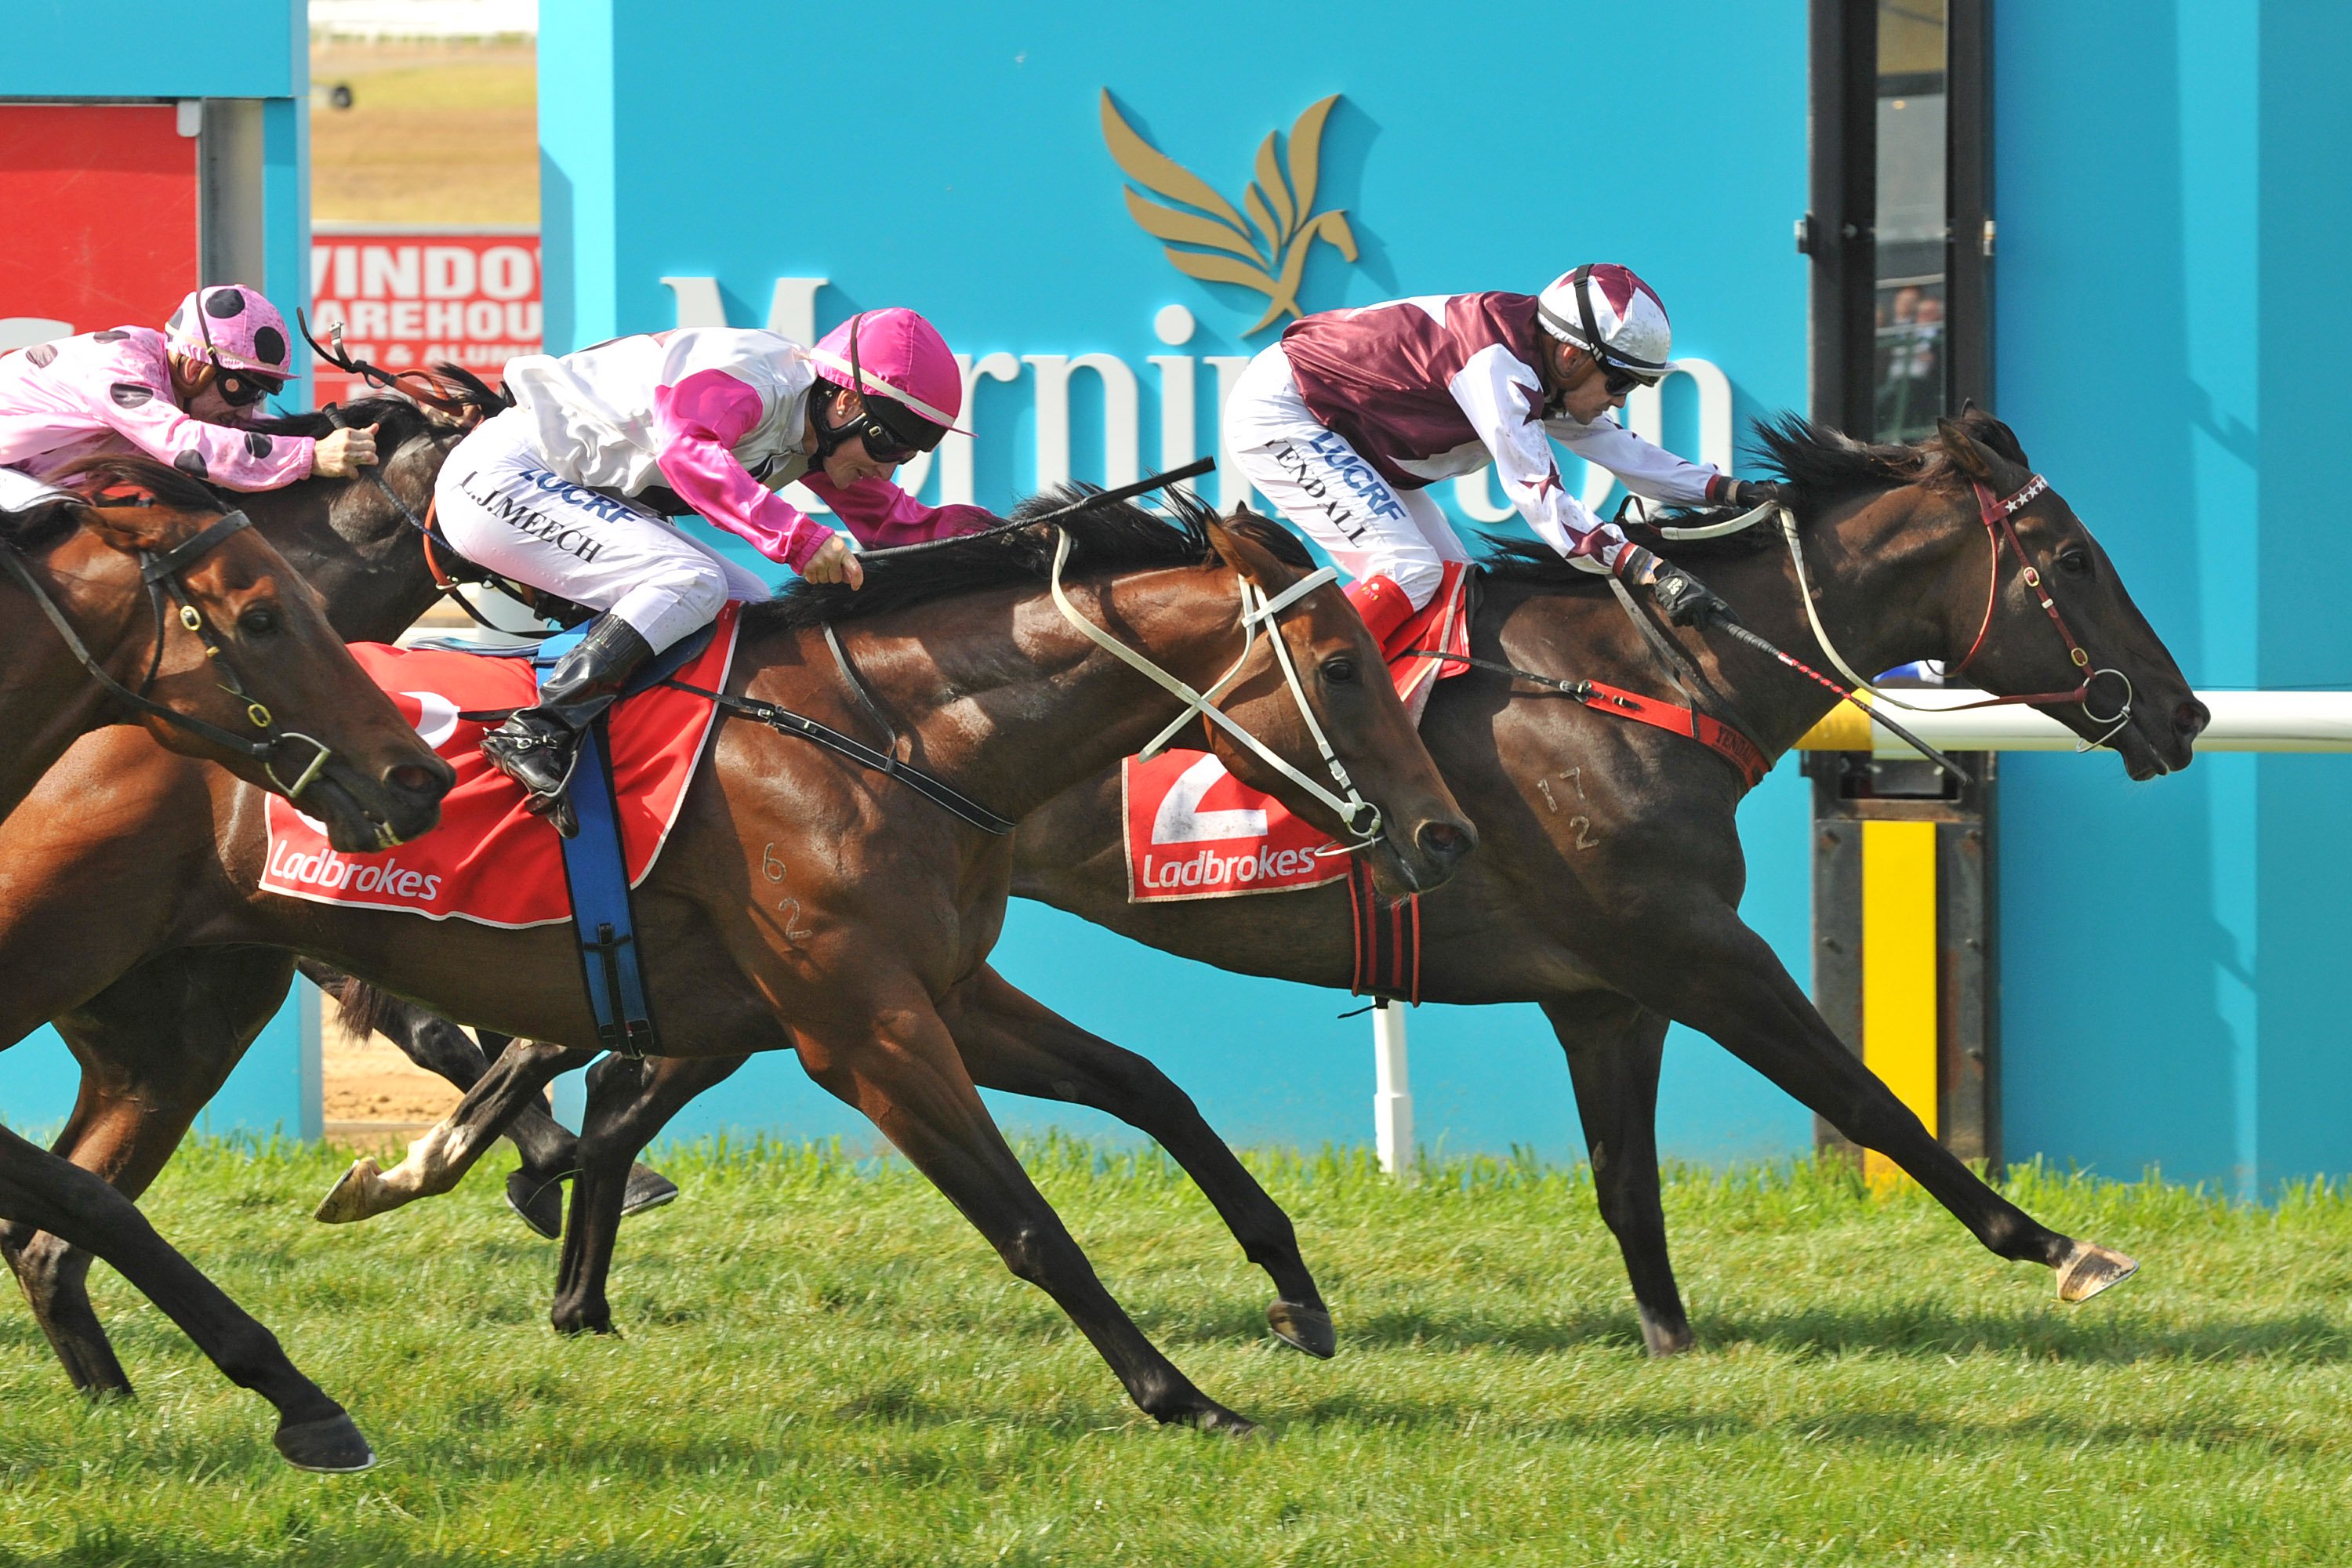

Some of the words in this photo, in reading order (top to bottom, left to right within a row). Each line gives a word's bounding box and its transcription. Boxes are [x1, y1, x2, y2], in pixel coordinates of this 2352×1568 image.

[311, 245, 542, 299] INDO
[519, 469, 637, 524] LUCRF
[1308, 430, 1406, 521] LUCRF
[1151, 753, 1269, 845] 2
[1570, 815, 1599, 851] 2
[270, 840, 441, 901] Ladbrokes
[762, 842, 787, 884] 6
[1142, 845, 1316, 889] Ladbrokes
[778, 898, 813, 939] 2
